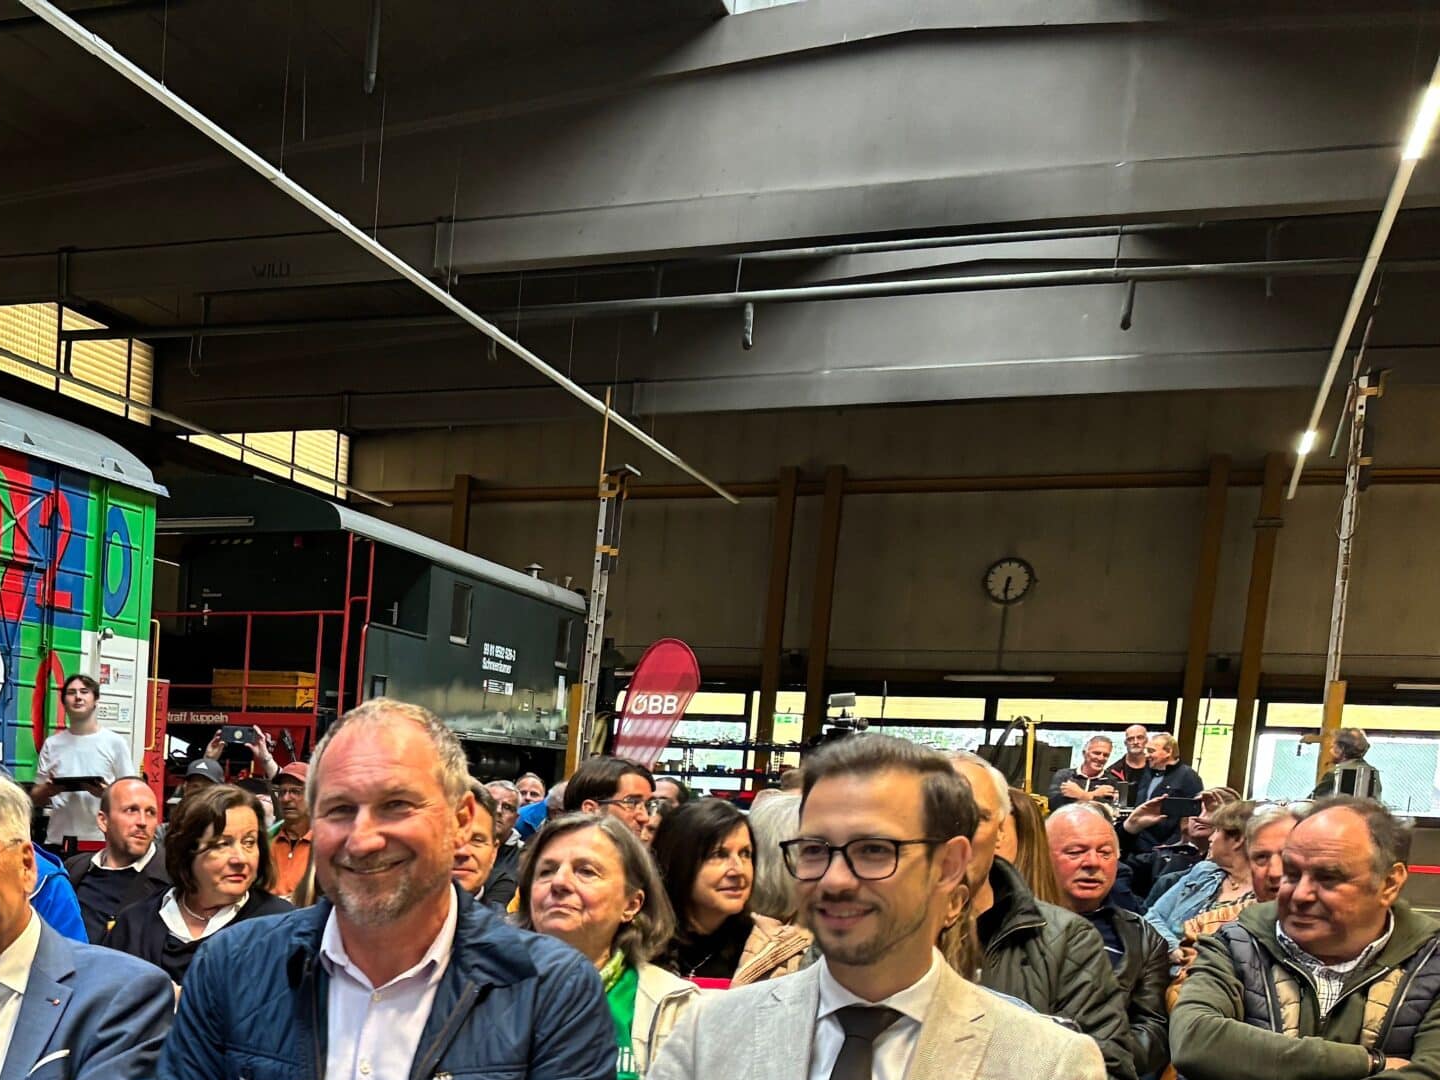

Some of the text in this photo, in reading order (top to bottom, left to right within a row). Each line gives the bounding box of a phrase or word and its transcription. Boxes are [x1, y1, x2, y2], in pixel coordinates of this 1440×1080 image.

[631, 694, 679, 715] ÖBB
[167, 712, 229, 723] traff kuppeln
